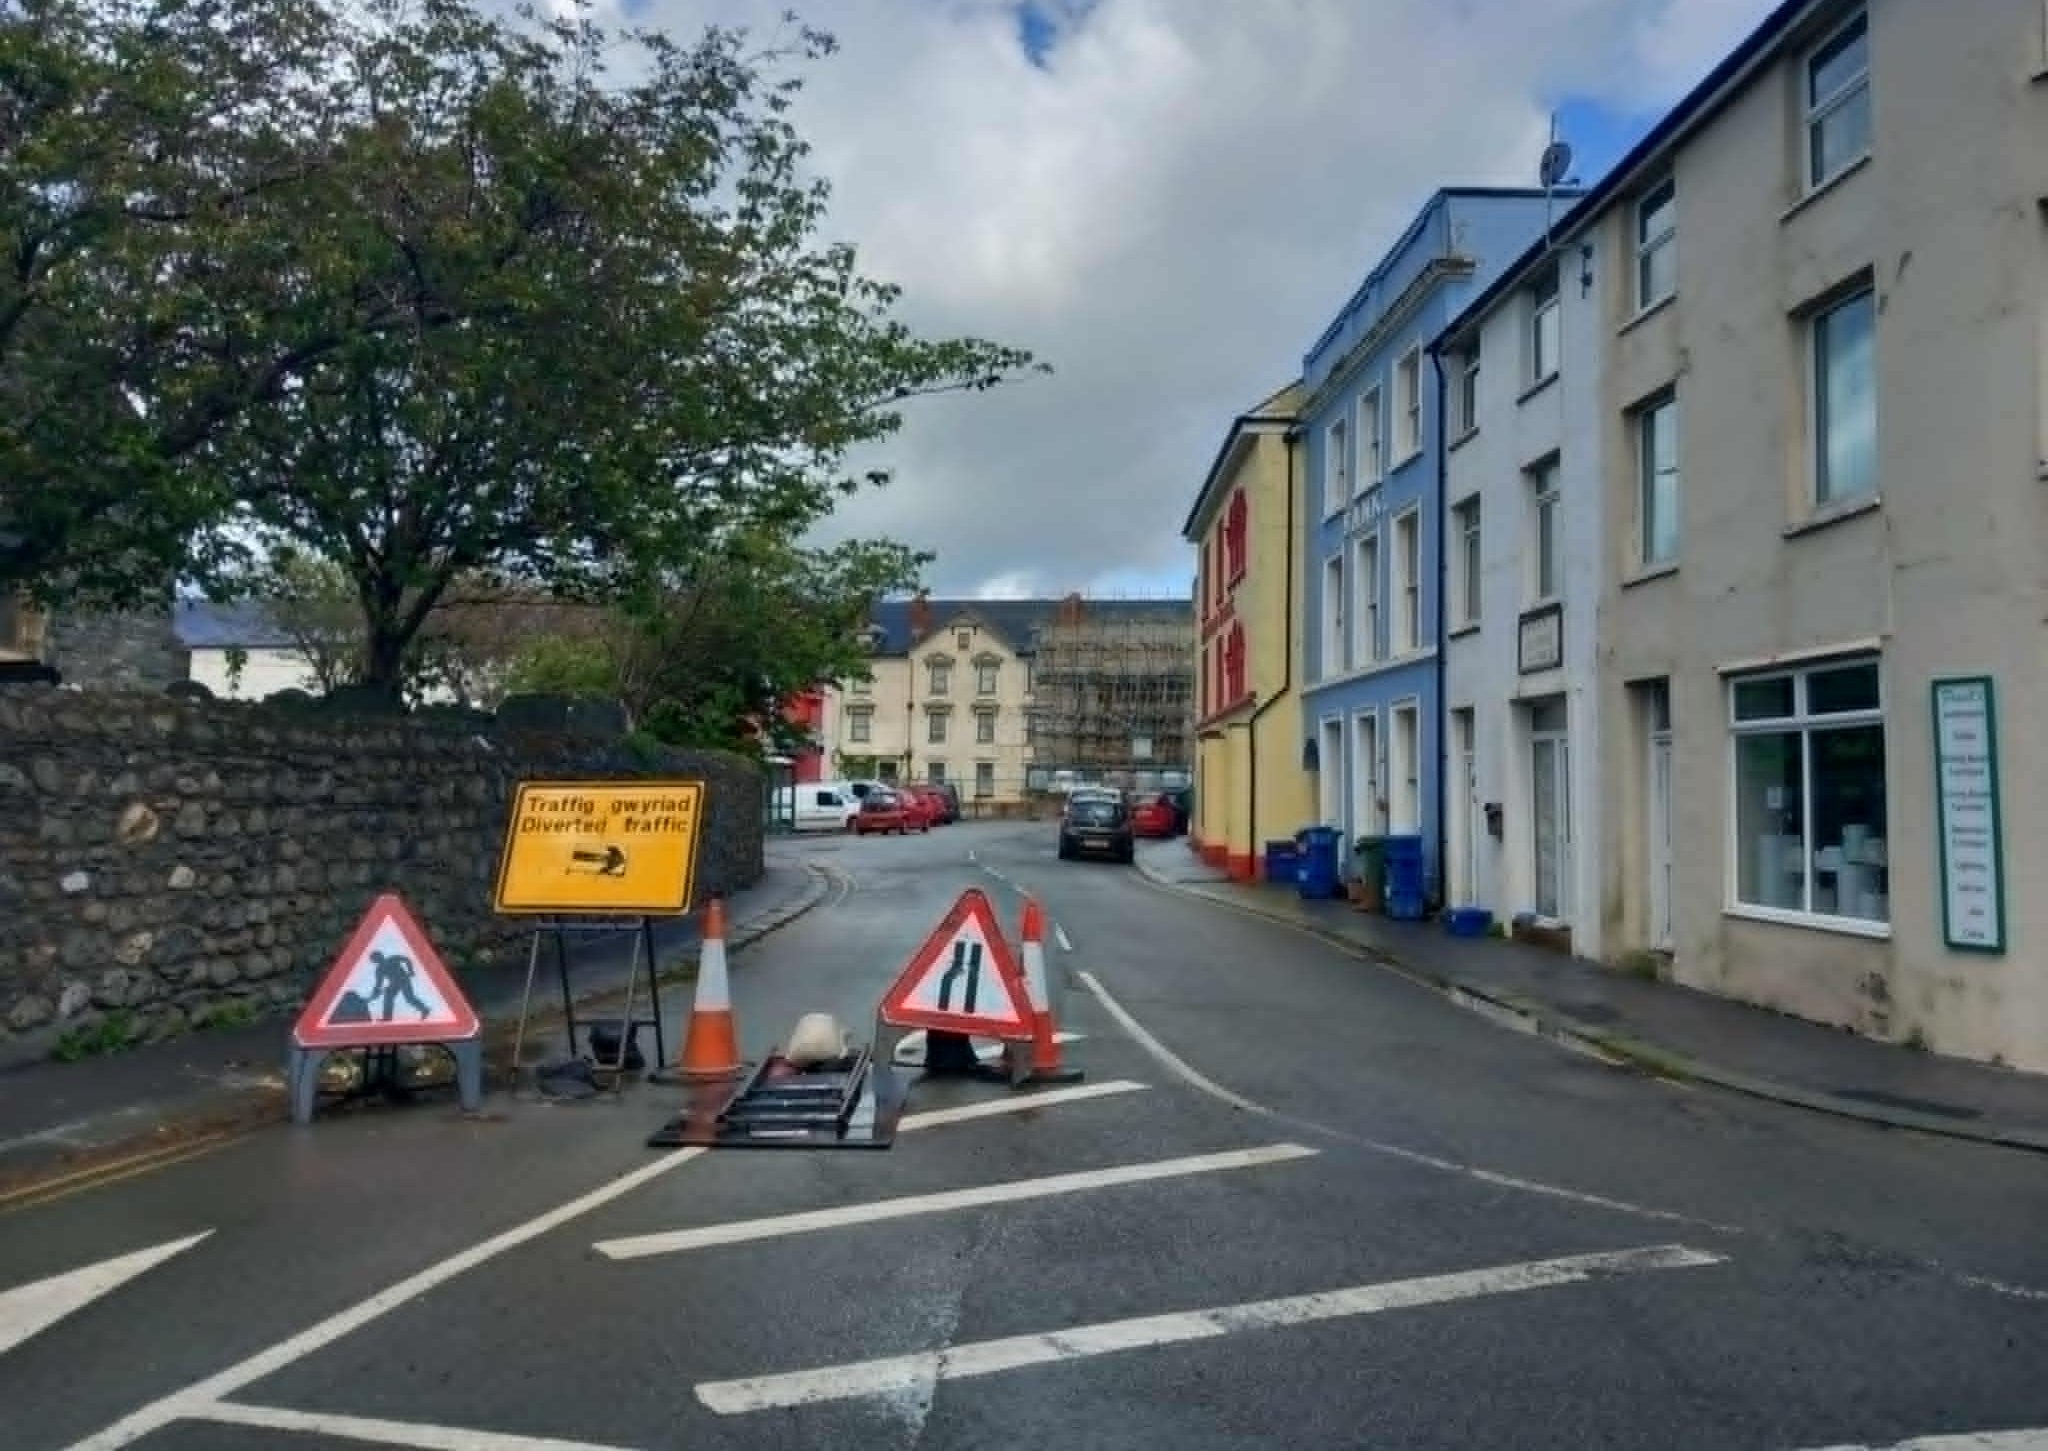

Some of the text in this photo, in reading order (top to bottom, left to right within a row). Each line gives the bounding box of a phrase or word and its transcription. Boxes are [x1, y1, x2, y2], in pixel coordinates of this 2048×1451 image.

[528, 795, 690, 814] Traffig gwyriad
[521, 816, 689, 834] Diverted traffic
